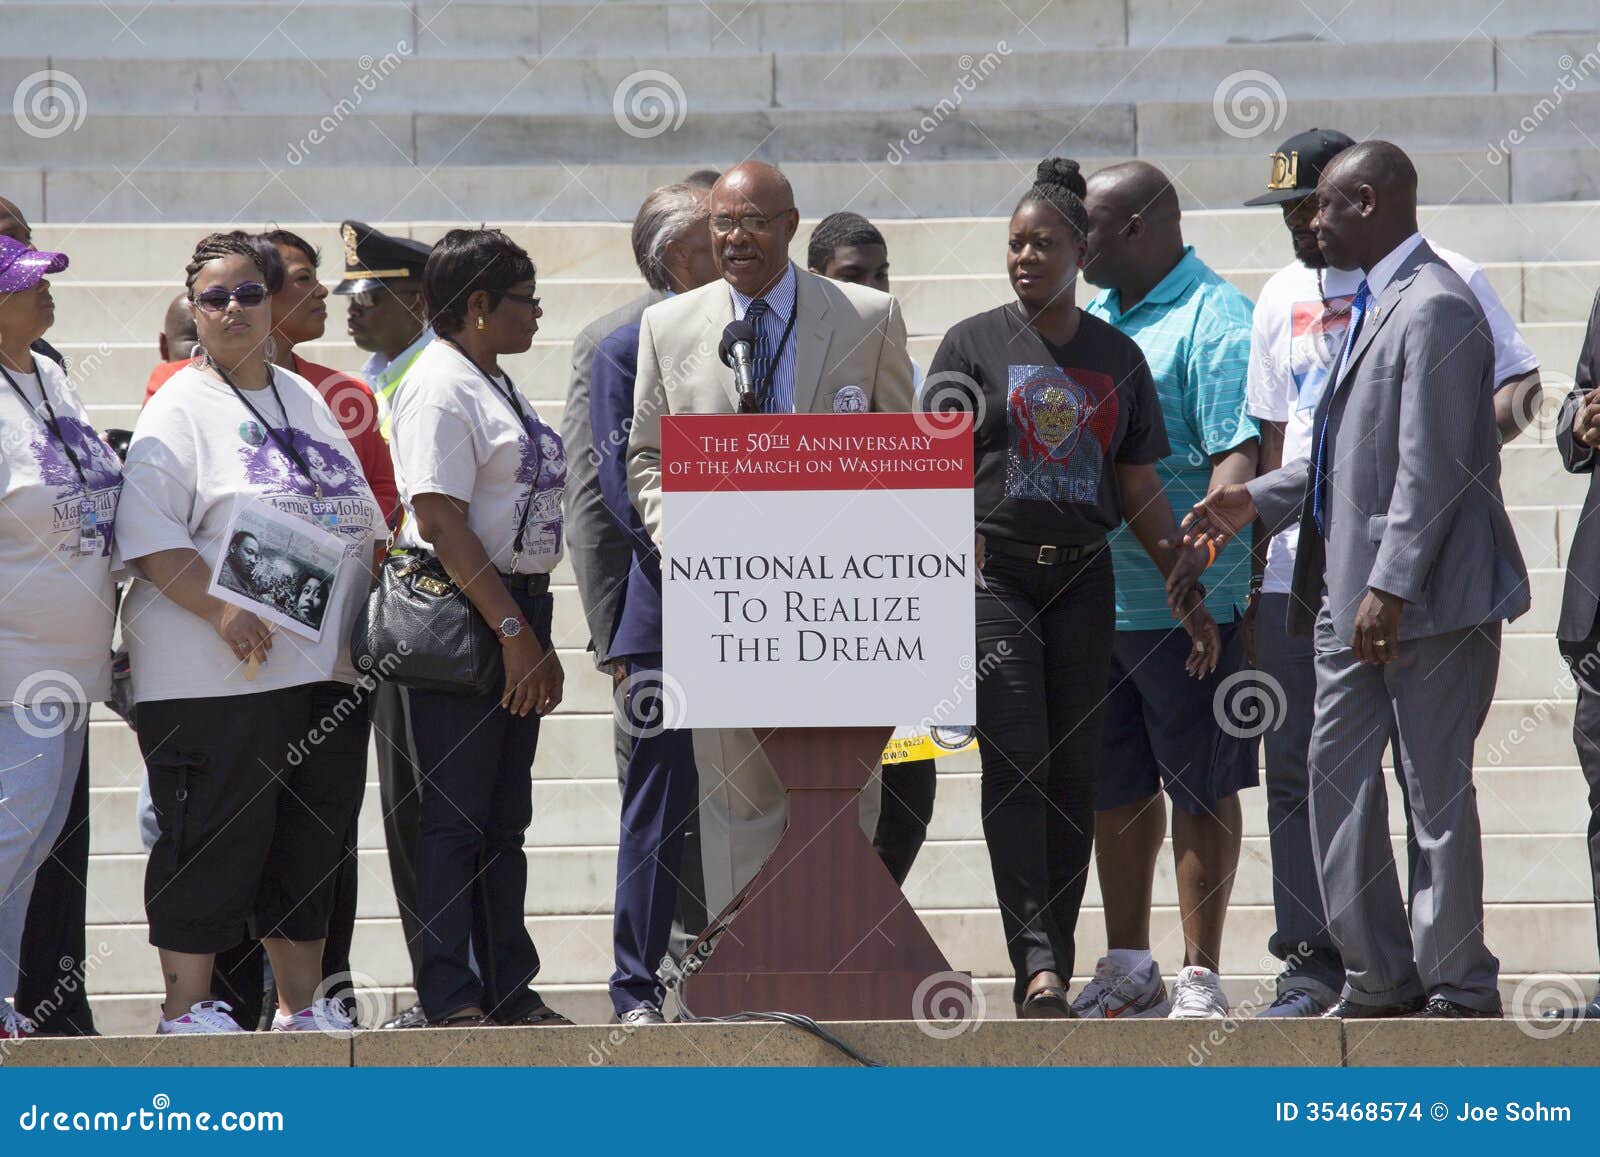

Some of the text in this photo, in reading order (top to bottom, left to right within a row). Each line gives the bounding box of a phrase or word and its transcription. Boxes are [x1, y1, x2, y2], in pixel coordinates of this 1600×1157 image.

[700, 433, 933, 452] THE 50TH ANNIVERSARY
[669, 457, 963, 475] OF THE MARCH ON WASHINGTON
[312, 502, 336, 514] SPR
[668, 553, 967, 581] NATIONAL ACTION
[714, 590, 921, 623] TO REALIZE
[711, 629, 926, 663] THE DREAM
